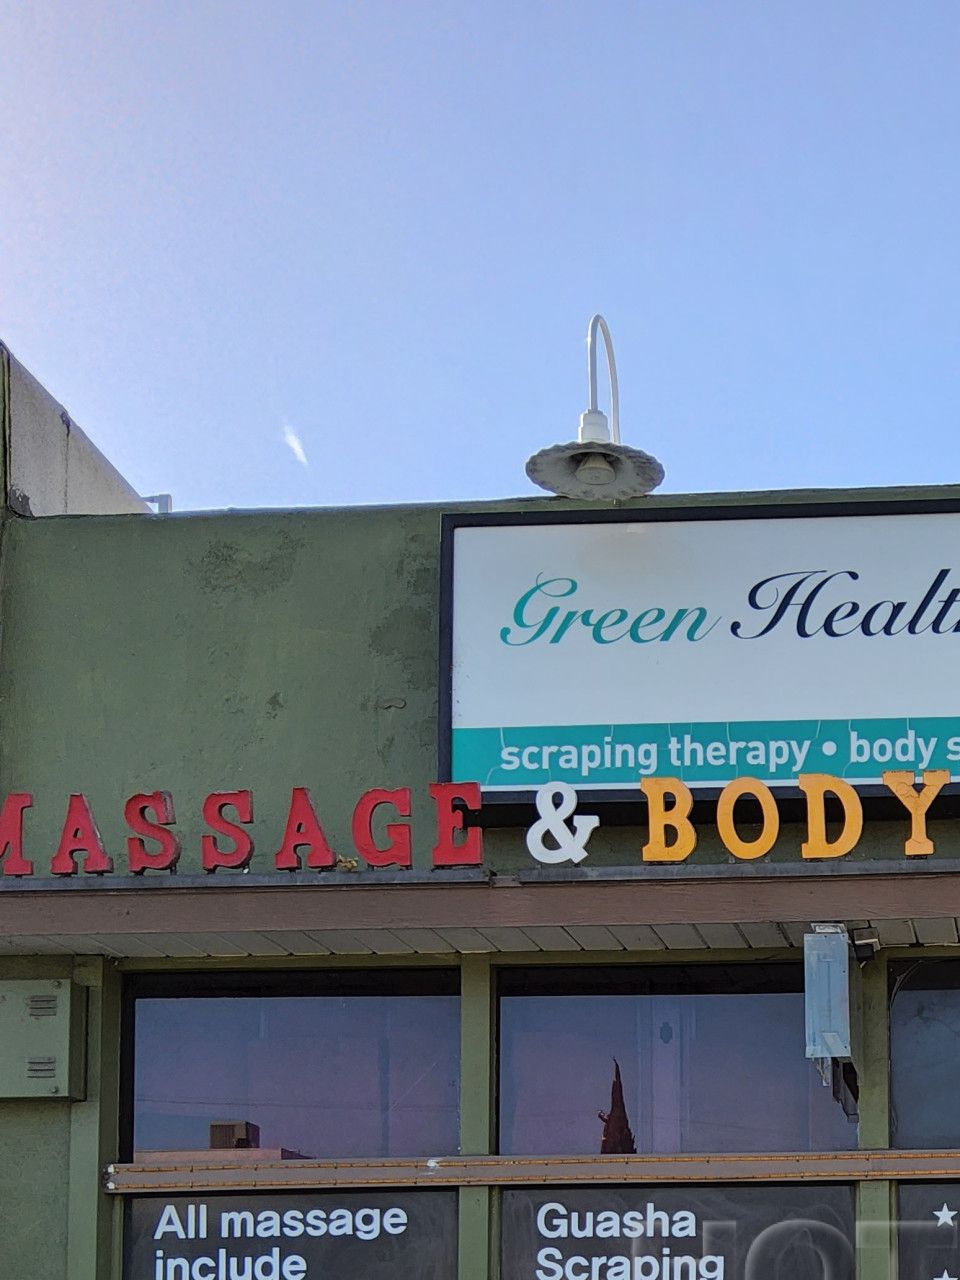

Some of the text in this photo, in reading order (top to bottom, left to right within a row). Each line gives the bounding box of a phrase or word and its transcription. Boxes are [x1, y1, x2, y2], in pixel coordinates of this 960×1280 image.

[500, 573, 721, 646] Green
[501, 735, 659, 776] scraping
[668, 731, 810, 771] therapy
[850, 729, 939, 769] body
[525, 781, 600, 865] &
[641, 769, 951, 863] BODY
[153, 1205, 408, 1240] All massage
[537, 1202, 696, 1239] Guasha
